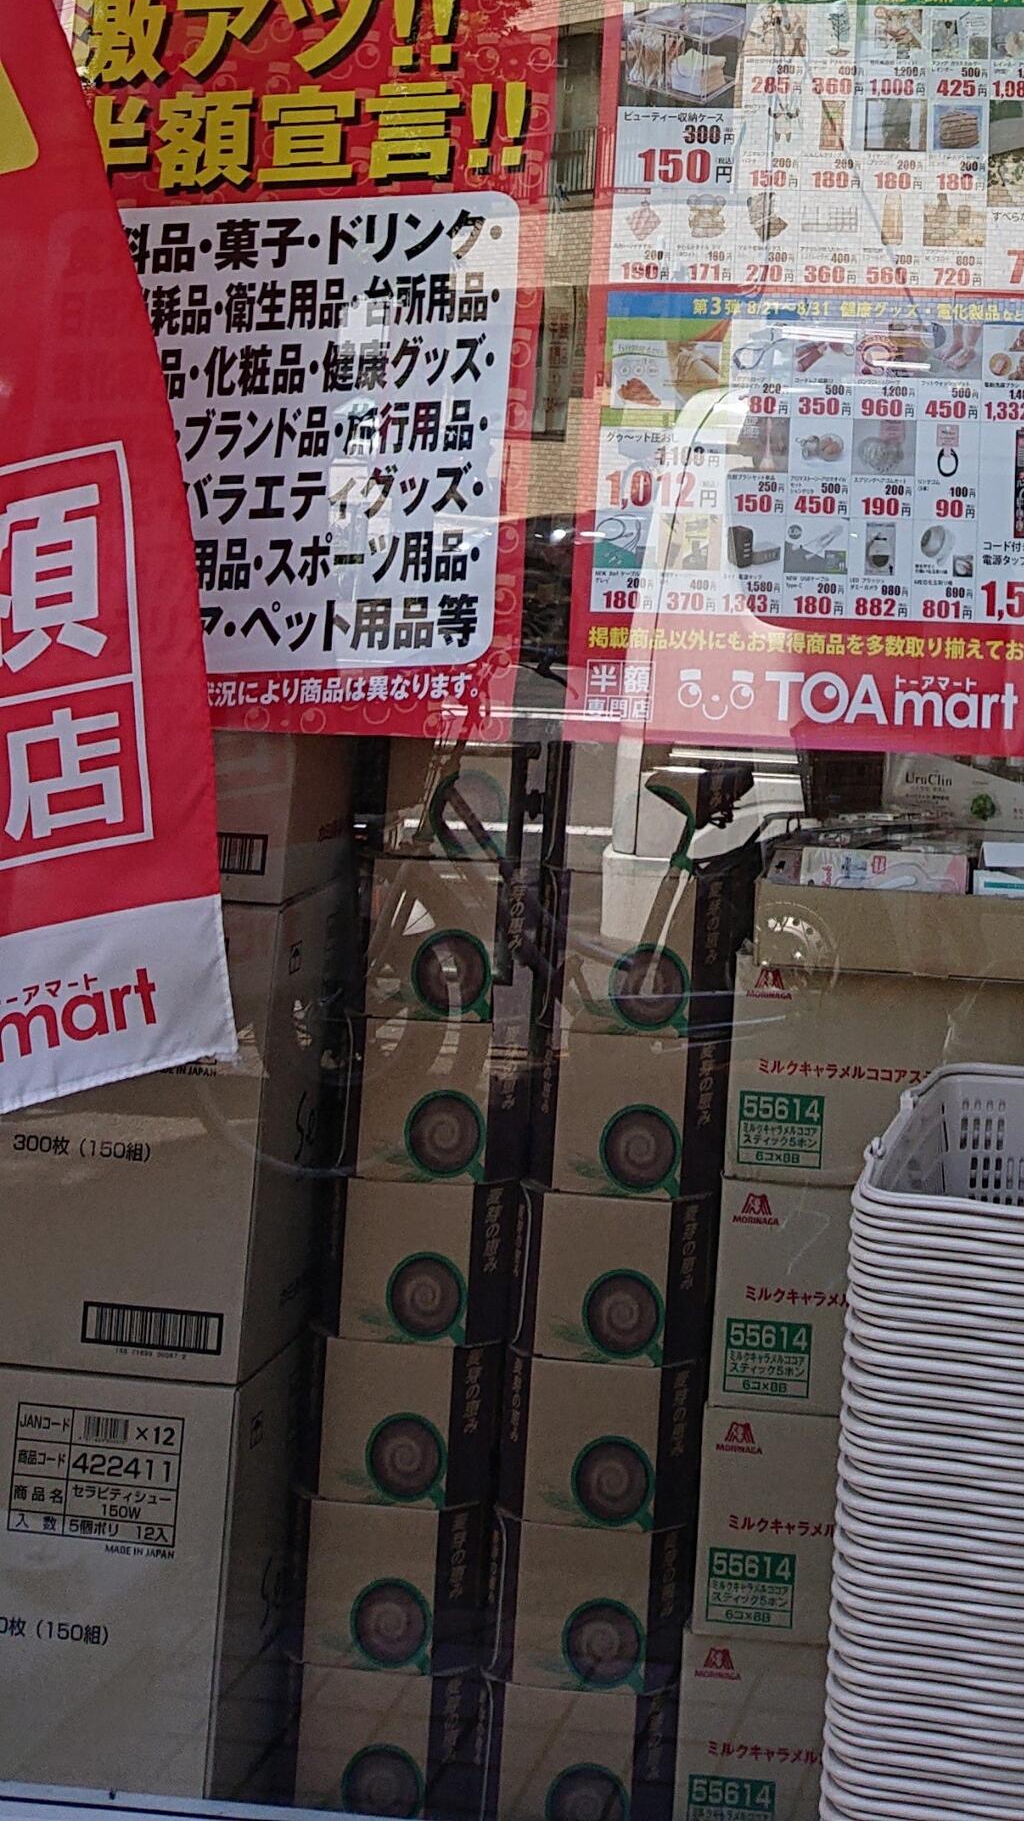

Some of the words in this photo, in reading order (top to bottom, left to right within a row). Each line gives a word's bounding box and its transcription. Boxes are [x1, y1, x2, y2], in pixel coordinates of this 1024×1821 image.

[5, 707, 124, 842] 店
[742, 1094, 821, 1123] 55614
[729, 1321, 809, 1351] 55614
[19, 1413, 71, 1433] JANコード
[17, 1449, 67, 1468] 商品コード
[71, 1451, 173, 1484] 422411
[712, 1552, 792, 1580] 55614
[690, 1779, 773, 1807] 55614
